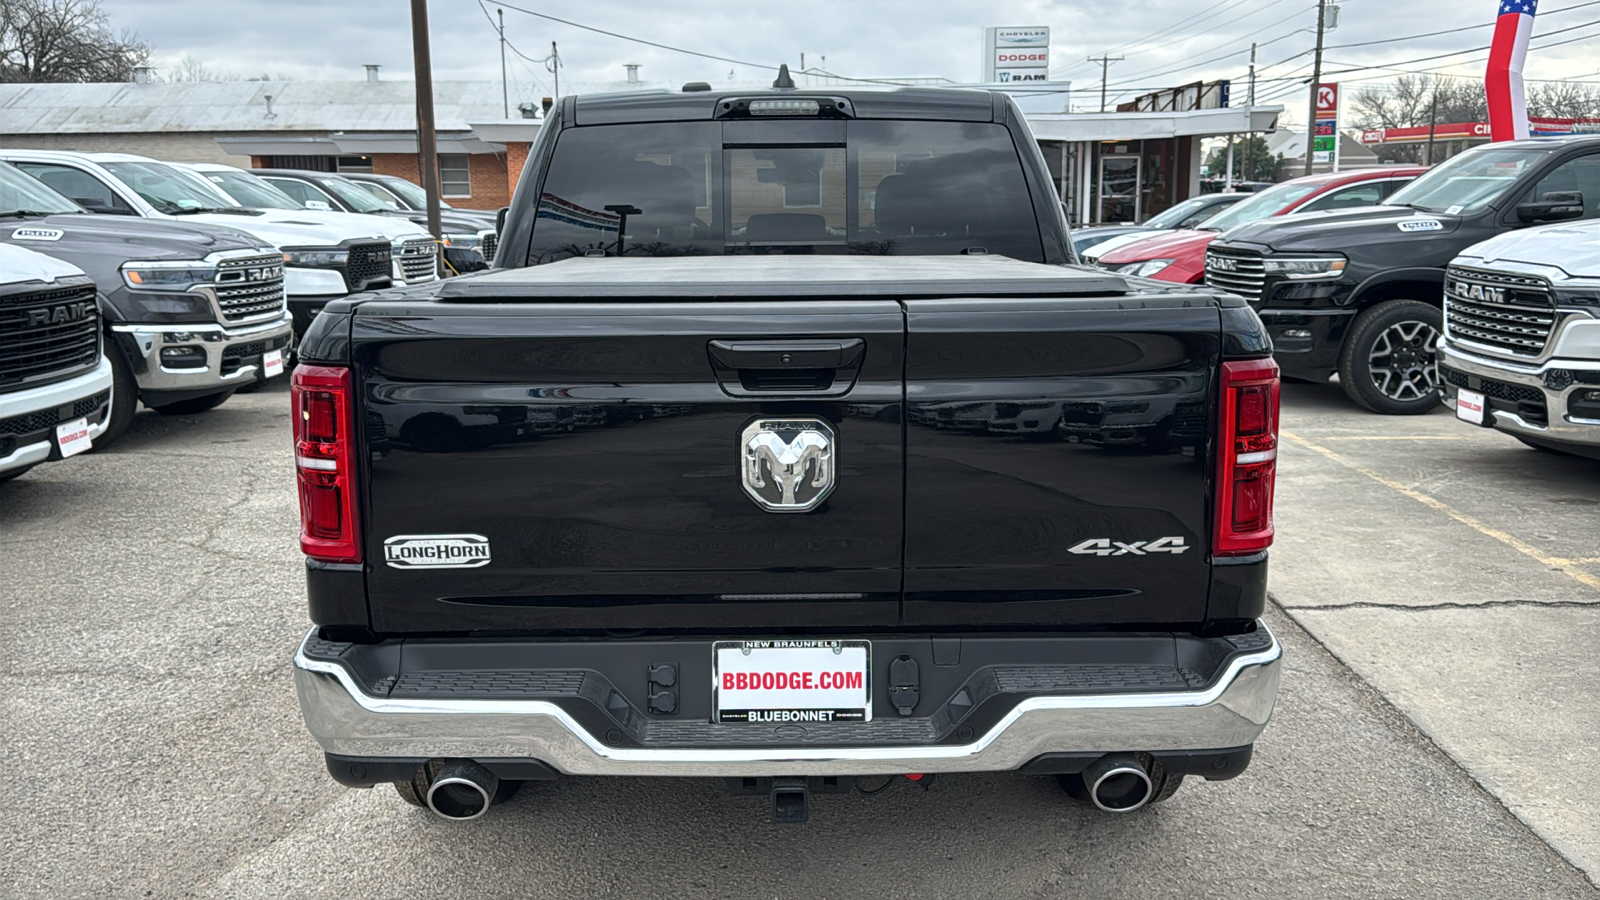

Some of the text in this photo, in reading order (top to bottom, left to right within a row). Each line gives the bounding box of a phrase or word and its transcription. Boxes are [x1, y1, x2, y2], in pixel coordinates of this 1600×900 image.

[1318, 91, 1332, 106] K
[1209, 257, 1237, 271] RAM
[248, 267, 281, 281] RAM
[1455, 282, 1505, 303] RAM
[28, 303, 87, 326] RAM
[764, 421, 817, 430] RAM
[1067, 536, 1191, 556] 4x4
[722, 671, 863, 690] BBDODGE.COM
[748, 710, 835, 722] BLUEBONNET
